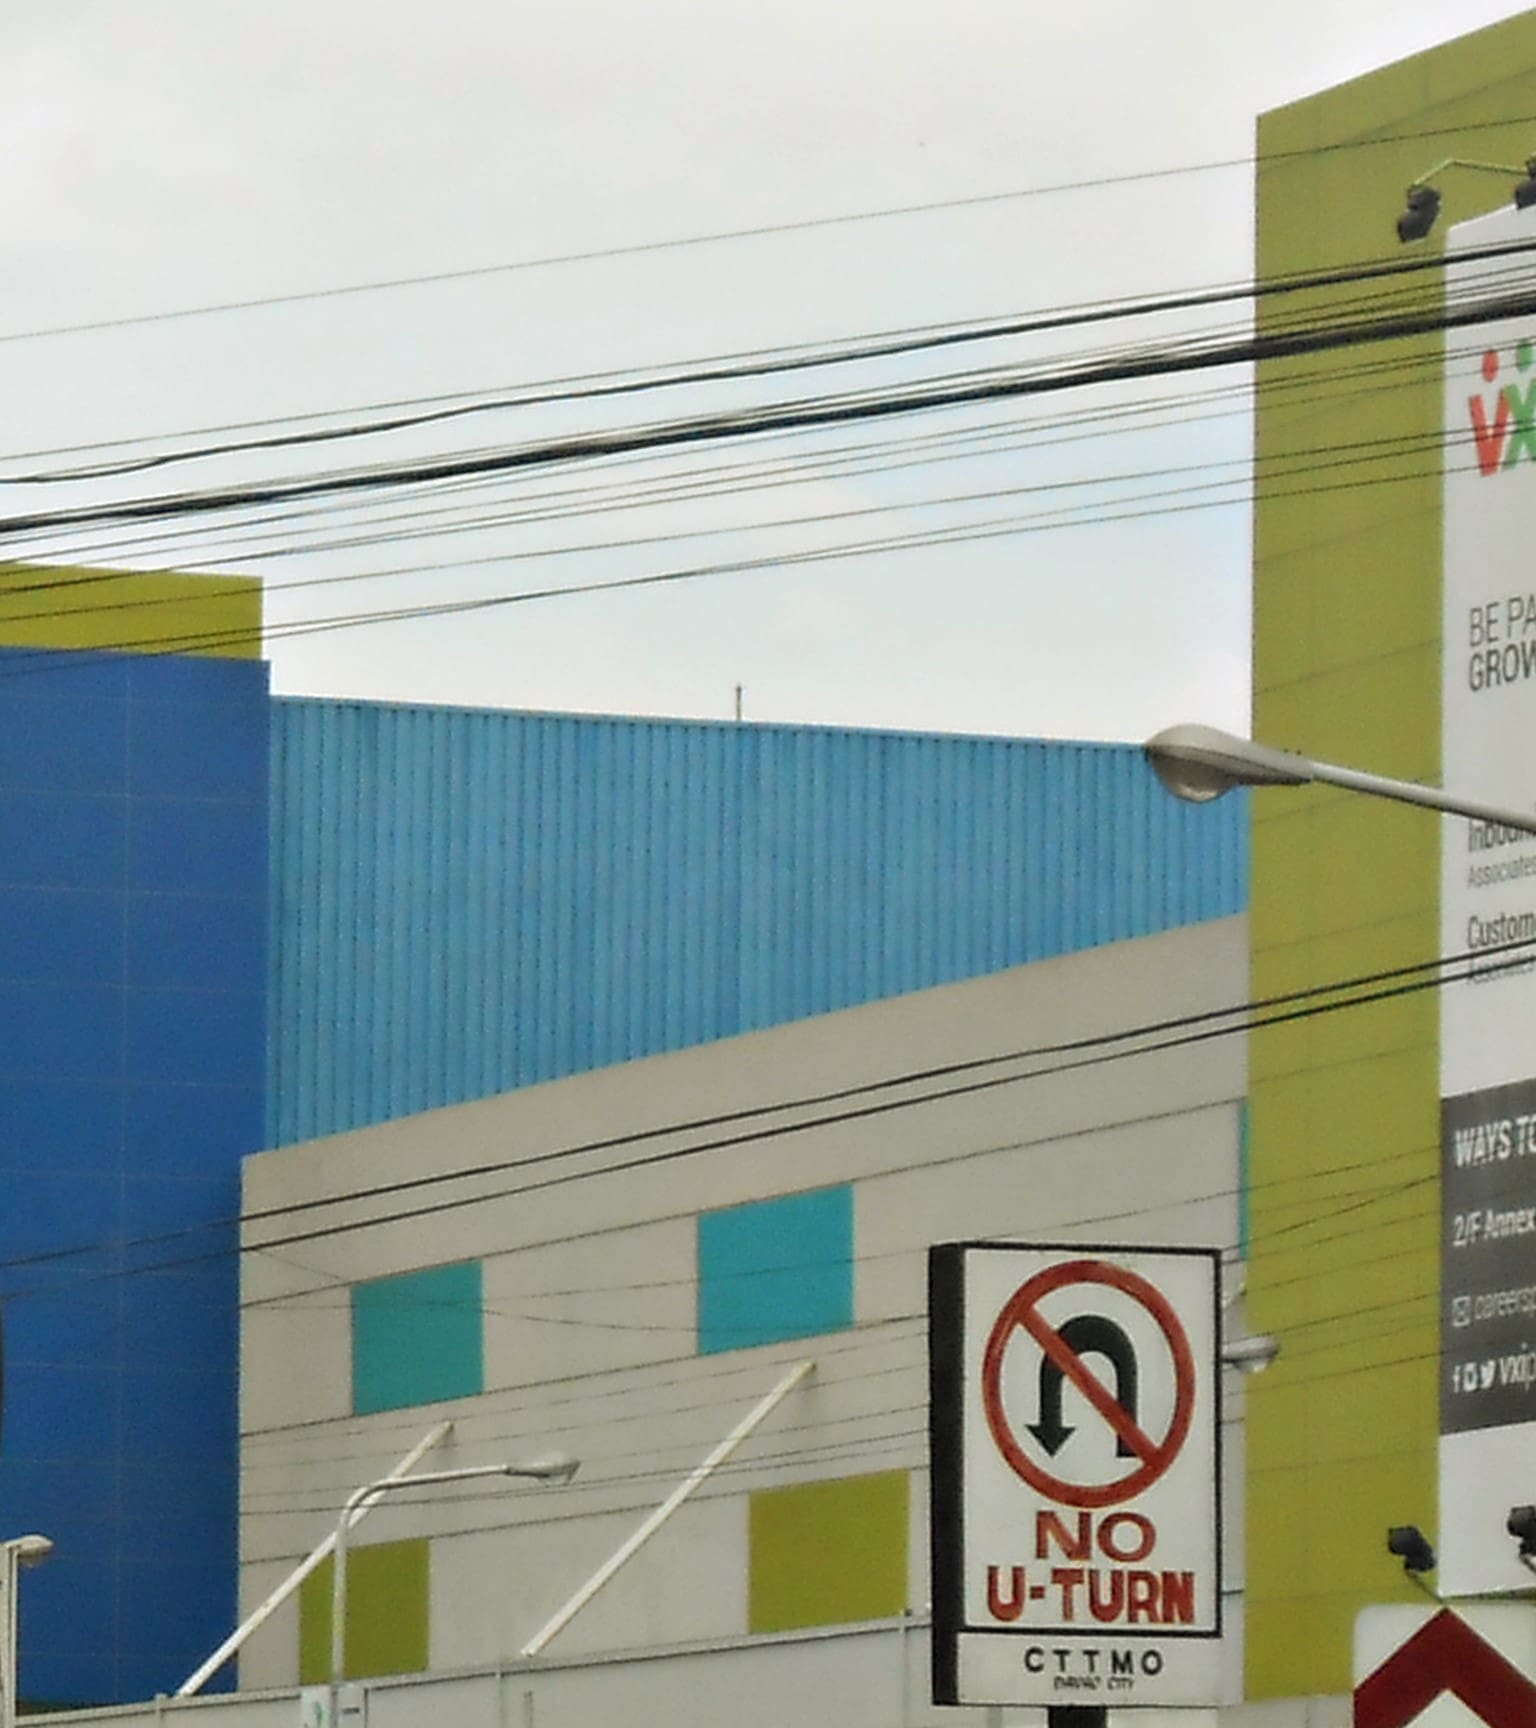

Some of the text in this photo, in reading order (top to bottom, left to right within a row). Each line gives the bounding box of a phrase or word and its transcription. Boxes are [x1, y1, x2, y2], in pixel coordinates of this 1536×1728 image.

[1469, 602, 1499, 647] BE
[1455, 1120, 1511, 1167] WAYS
[1035, 1510, 1156, 1562] NO
[987, 1566, 1195, 1623] U-TURN
[1024, 1647, 1163, 1676] CTTMO
